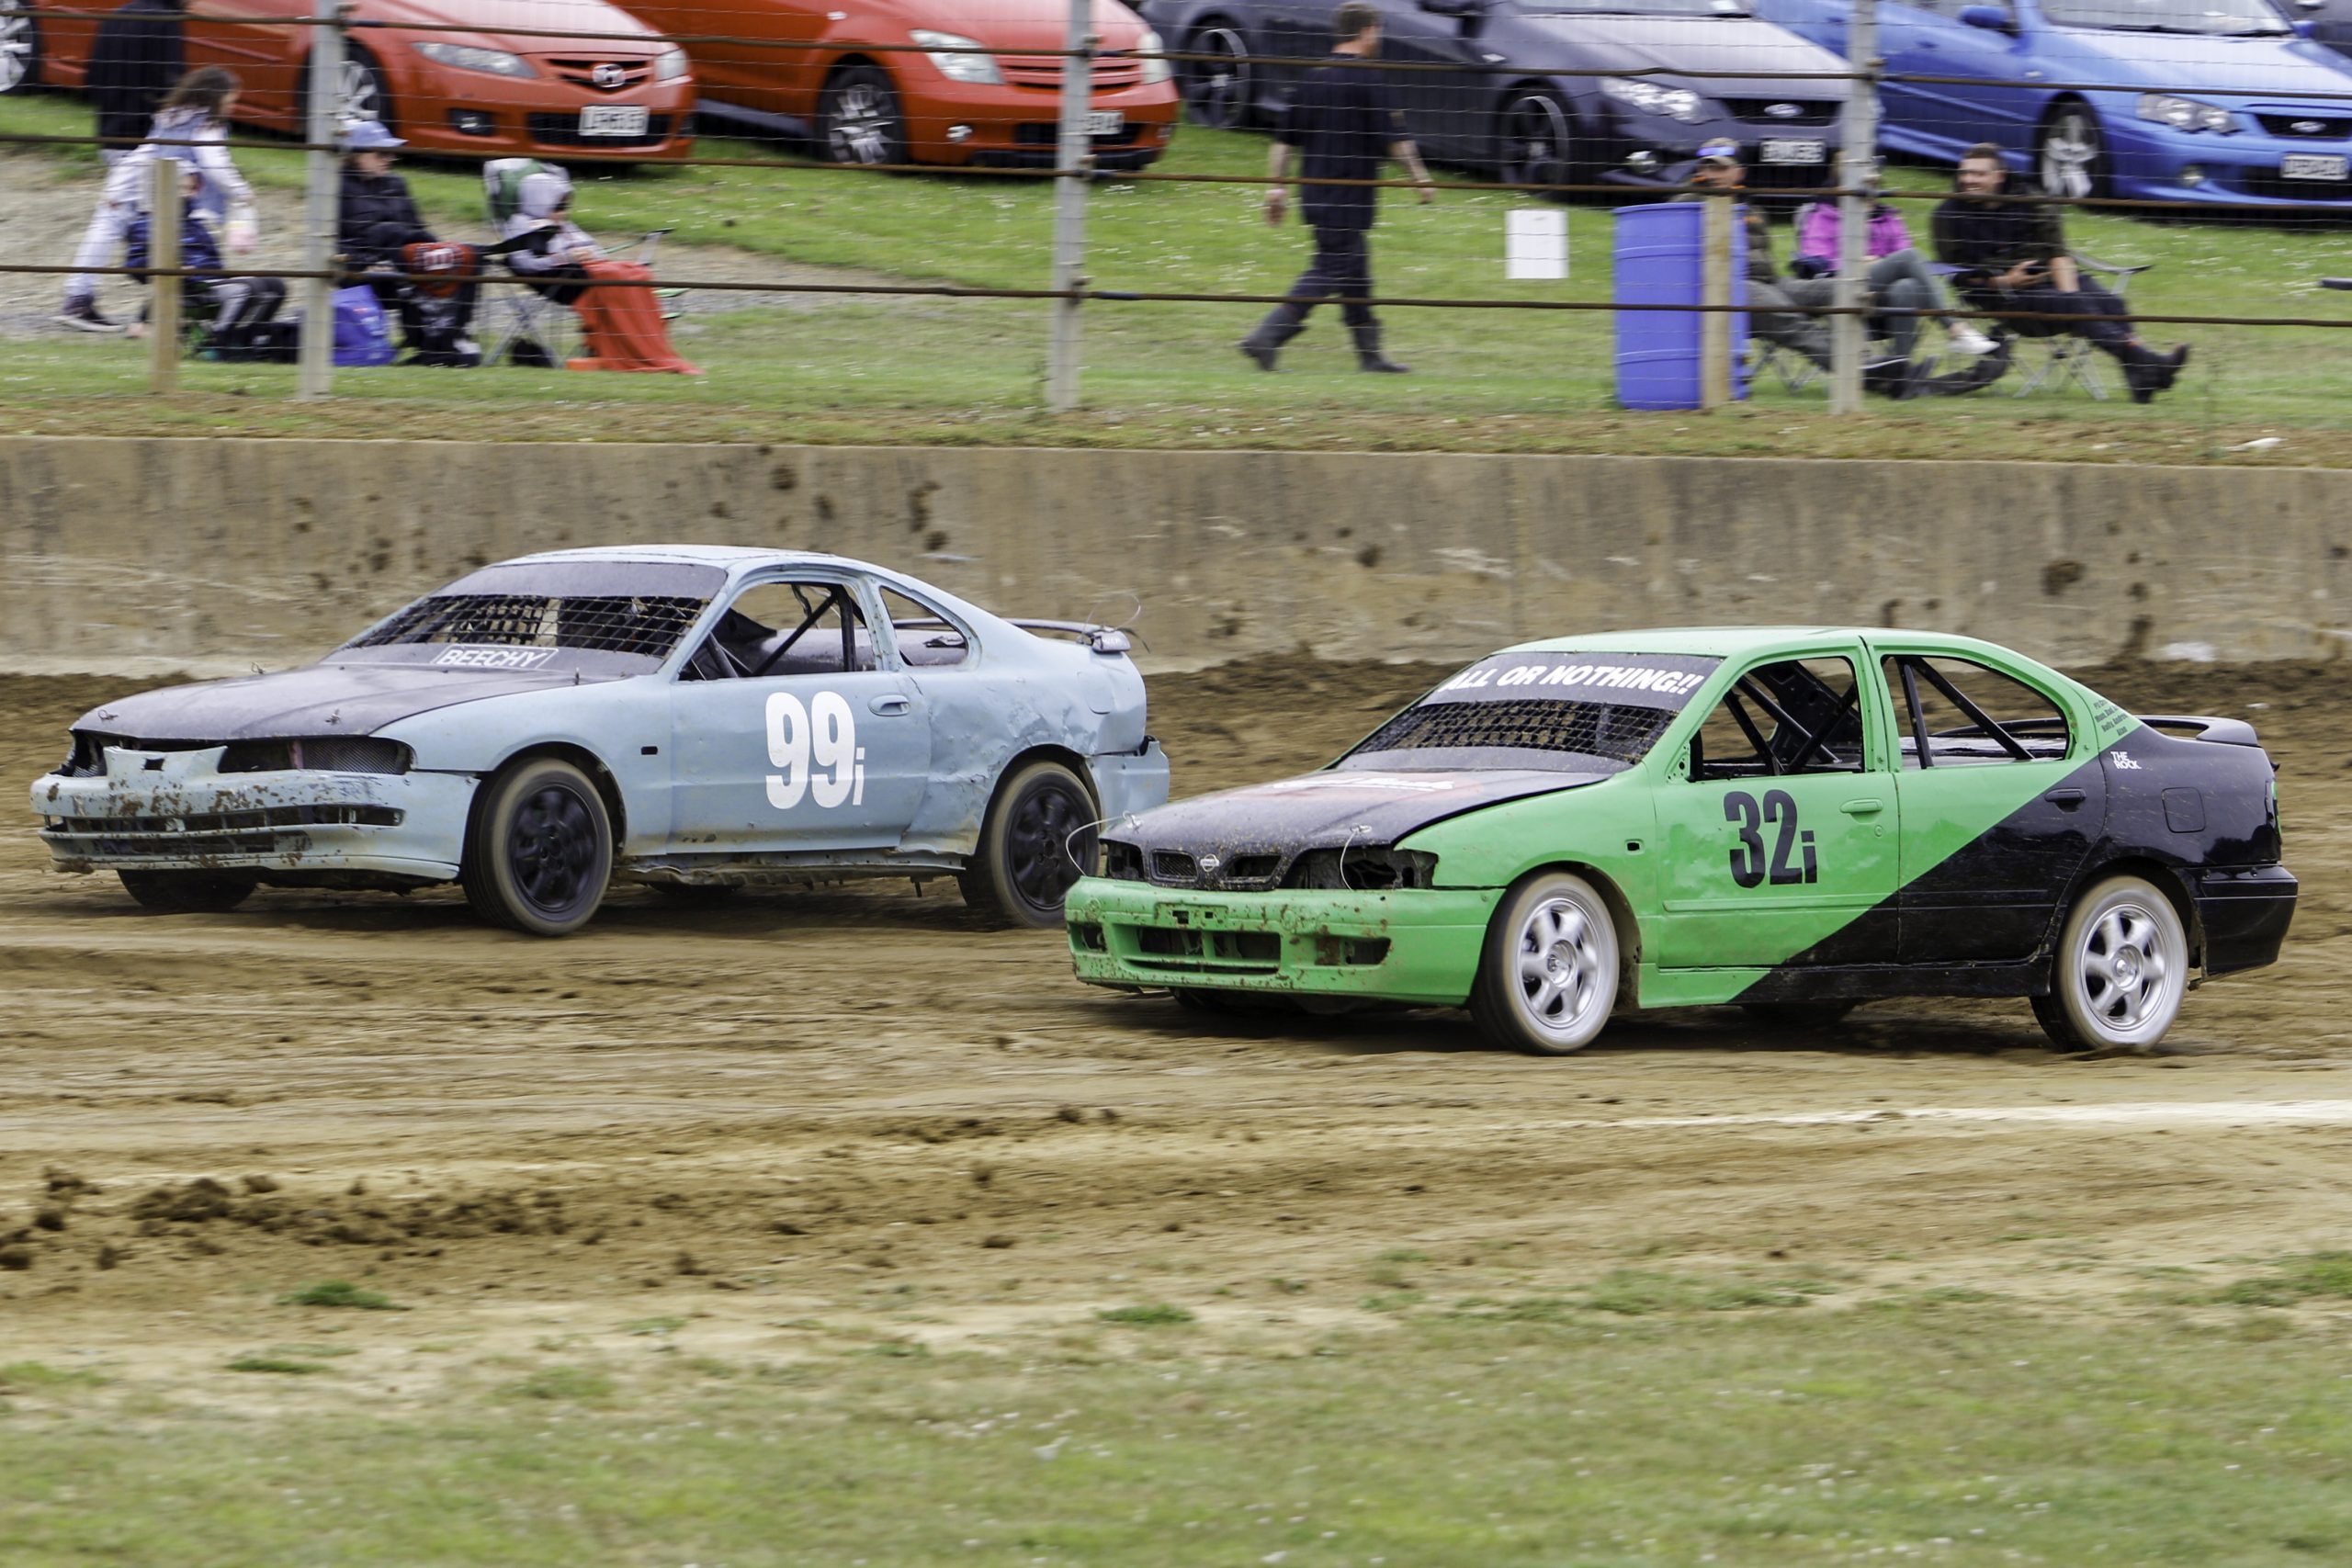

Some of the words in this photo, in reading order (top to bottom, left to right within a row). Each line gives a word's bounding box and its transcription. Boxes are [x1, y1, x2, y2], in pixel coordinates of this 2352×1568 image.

[436, 649, 548, 667] BEECHY
[1437, 668, 1498, 693] ALL
[1497, 665, 1548, 687] OR
[1542, 665, 1705, 694] NOTHING!!
[765, 691, 865, 809] 99i
[2109, 750, 2130, 761] THE
[2113, 760, 2143, 770] ROCK
[1724, 789, 1817, 888] 32i
